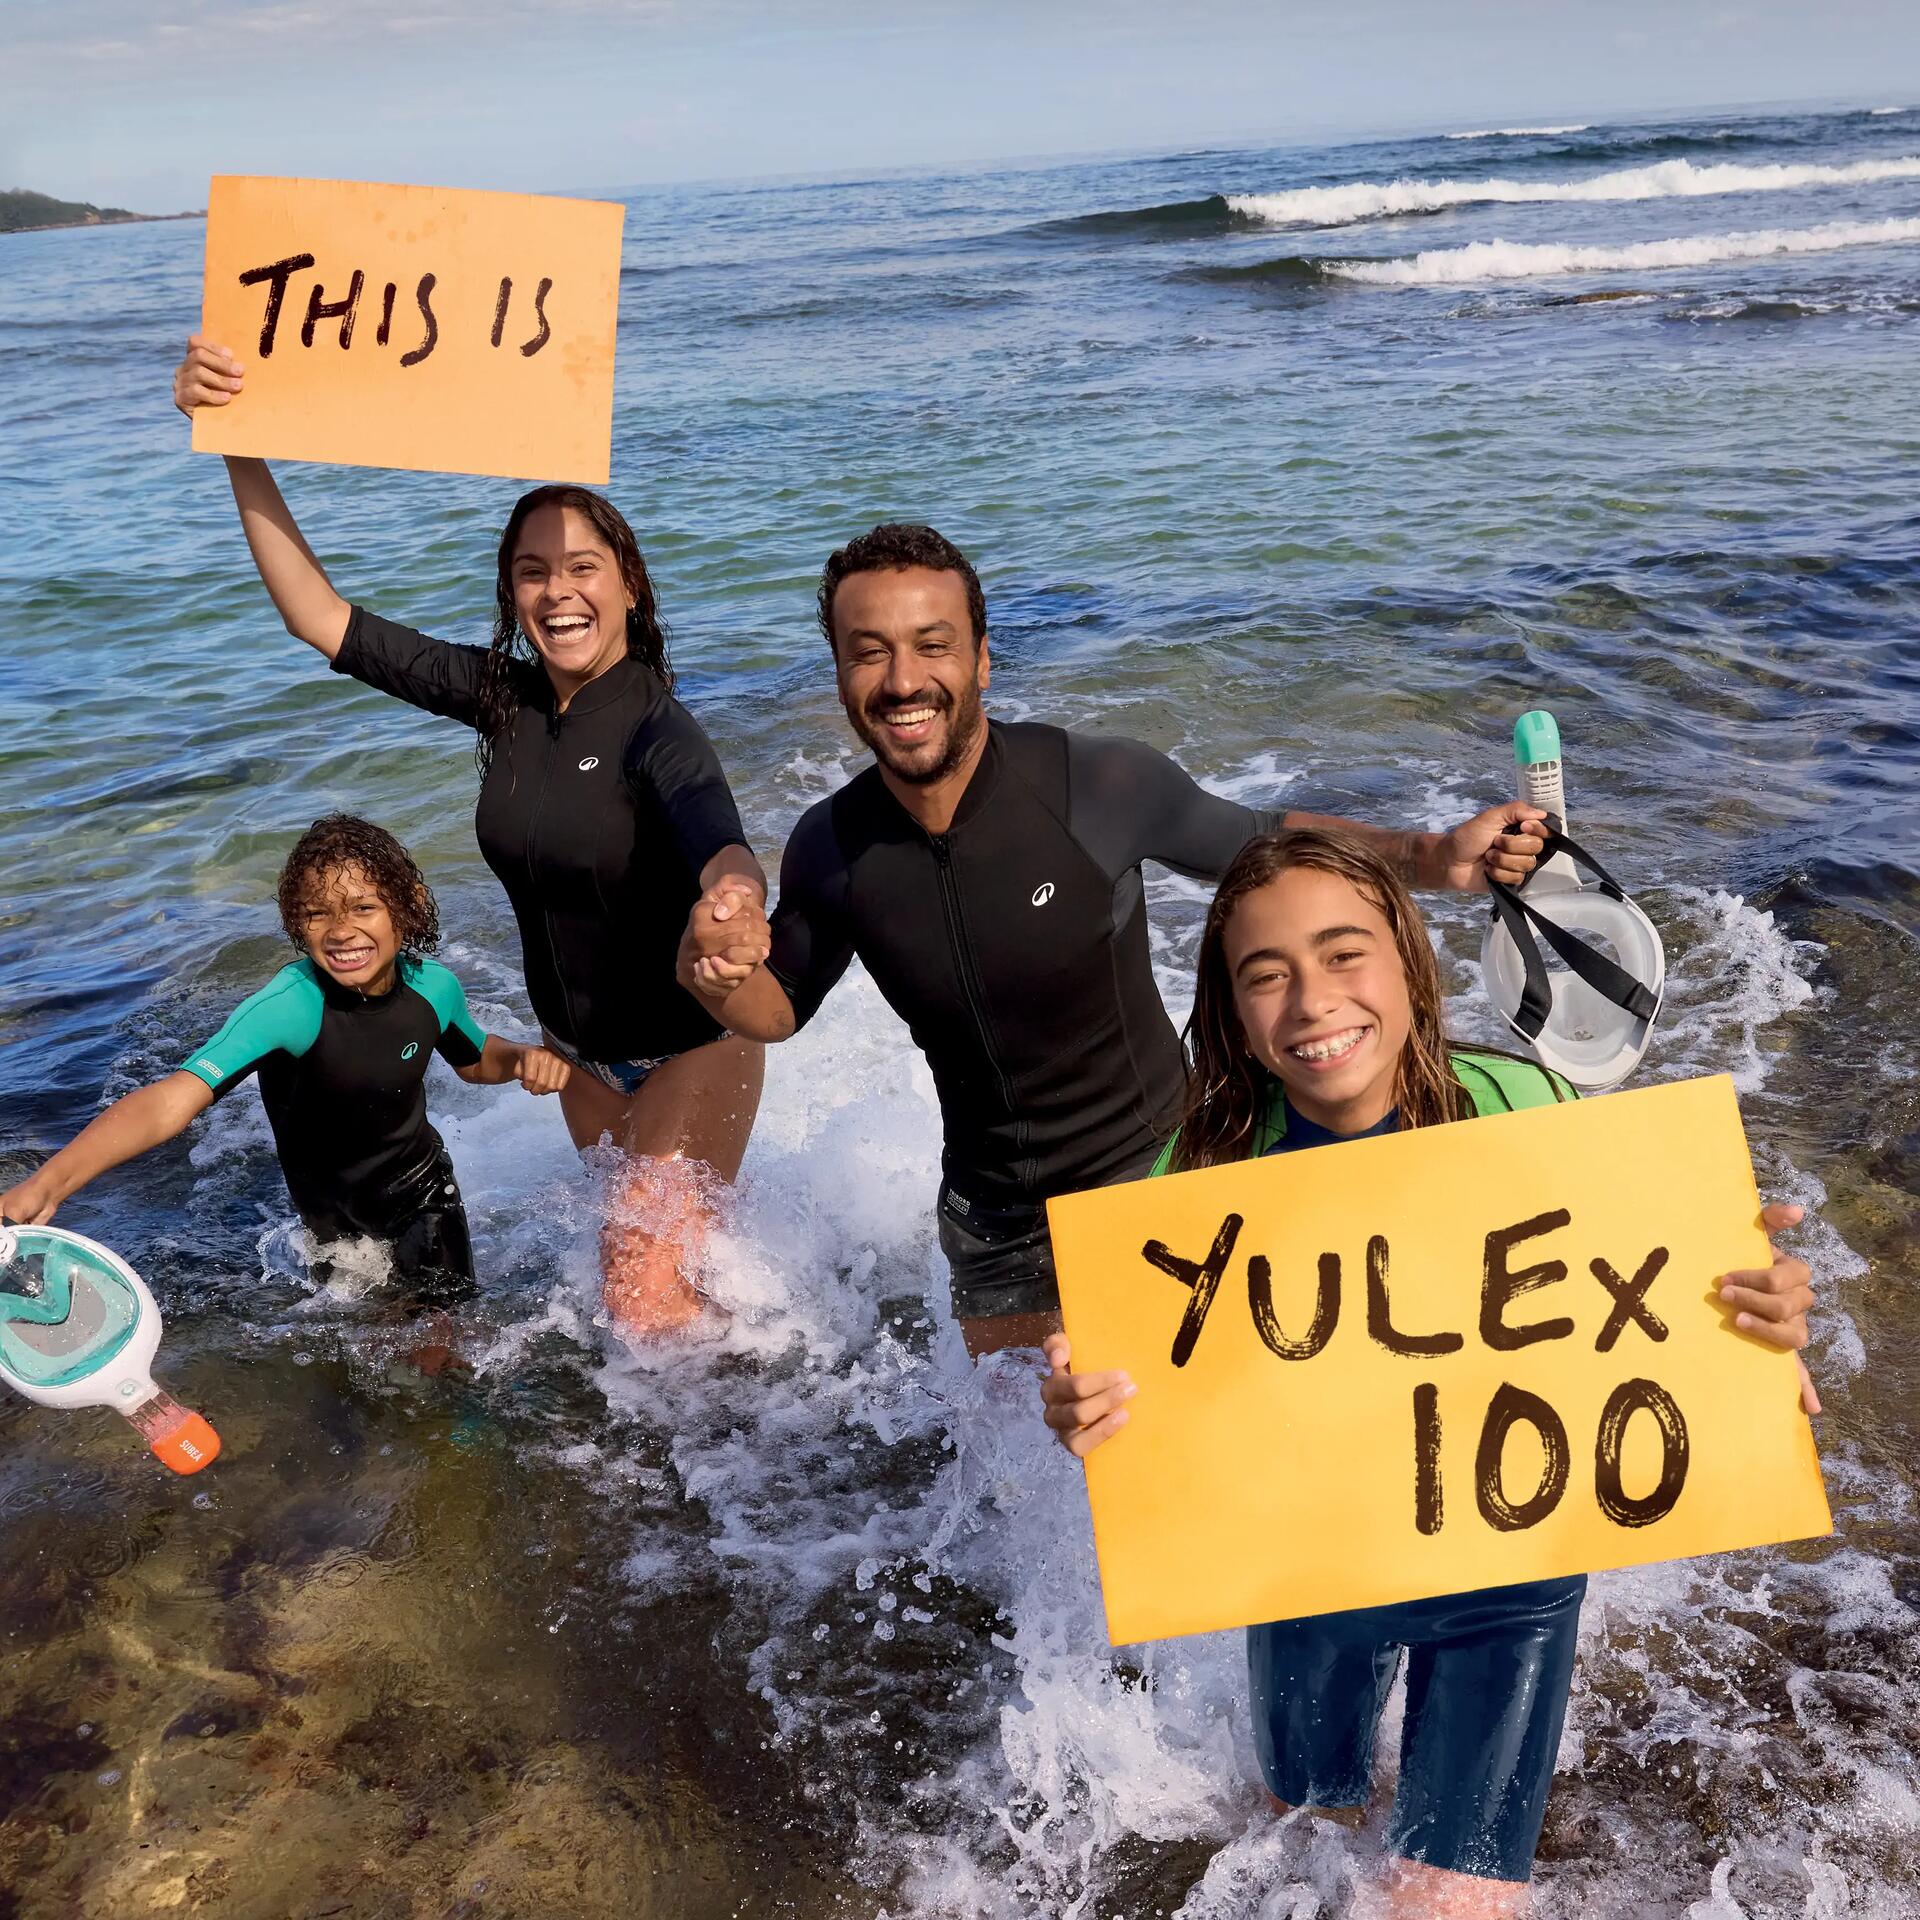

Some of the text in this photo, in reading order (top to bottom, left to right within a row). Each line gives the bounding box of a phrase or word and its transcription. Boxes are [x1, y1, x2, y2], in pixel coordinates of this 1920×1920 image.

[239, 253, 553, 368] THIS IS
[1141, 1208, 1669, 1368] YULEX
[179, 1439, 203, 1462] SUBEA
[1413, 1378, 1690, 1536] 100
